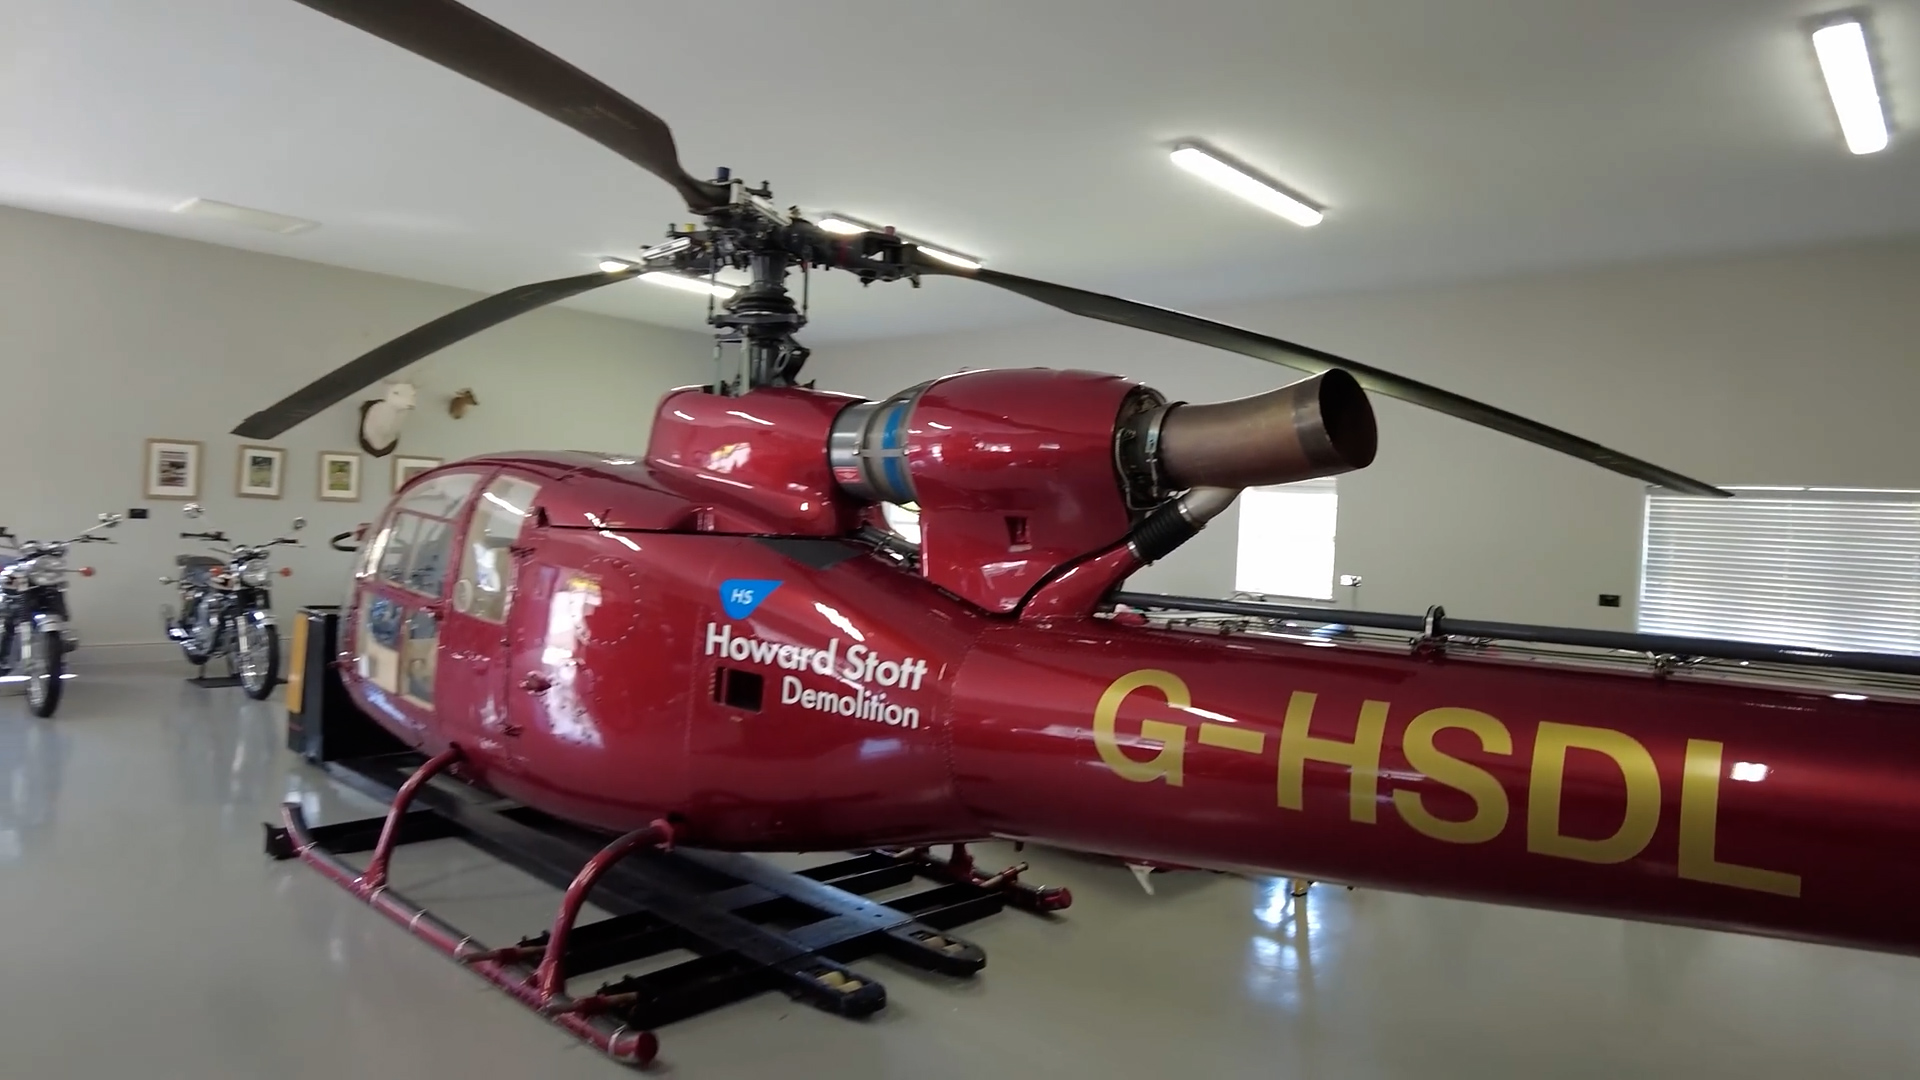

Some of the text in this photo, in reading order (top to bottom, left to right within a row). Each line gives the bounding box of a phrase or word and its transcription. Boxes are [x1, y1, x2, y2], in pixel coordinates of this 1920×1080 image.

[730, 588, 754, 606] HS
[705, 622, 928, 691] Howard Stott
[781, 675, 920, 729] Demolition
[1092, 668, 1803, 898] G-HSDL
